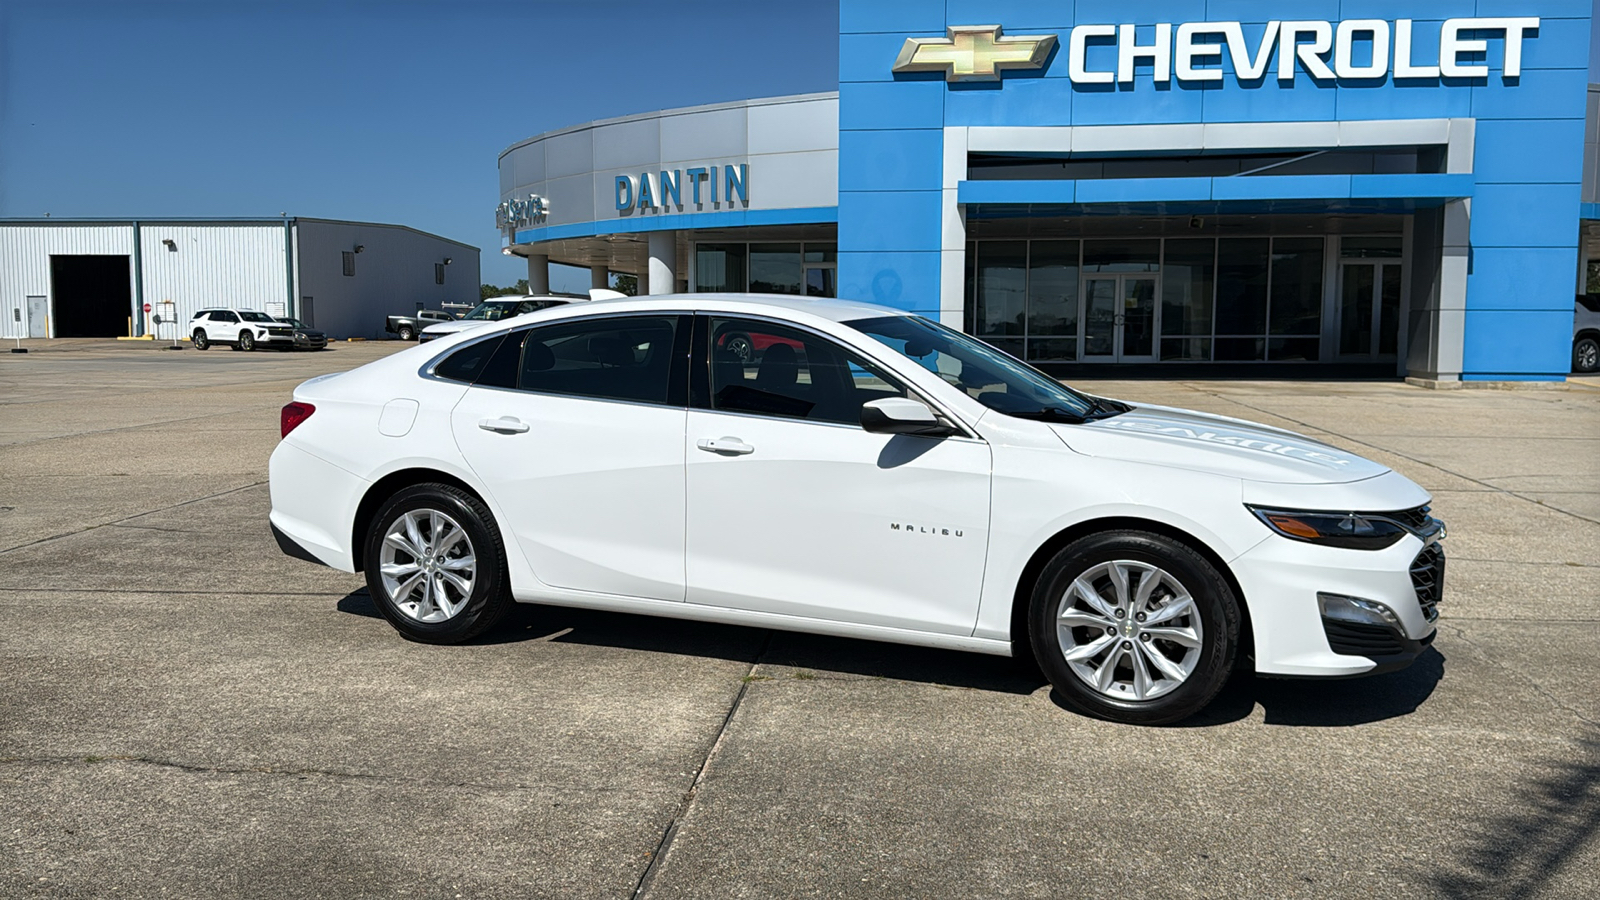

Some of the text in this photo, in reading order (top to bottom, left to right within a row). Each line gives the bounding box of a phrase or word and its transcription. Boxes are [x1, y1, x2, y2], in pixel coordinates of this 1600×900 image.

[1069, 17, 1540, 84] CHEVROLET
[615, 164, 747, 211] DANTIN
[890, 523, 963, 537] MALIBU
